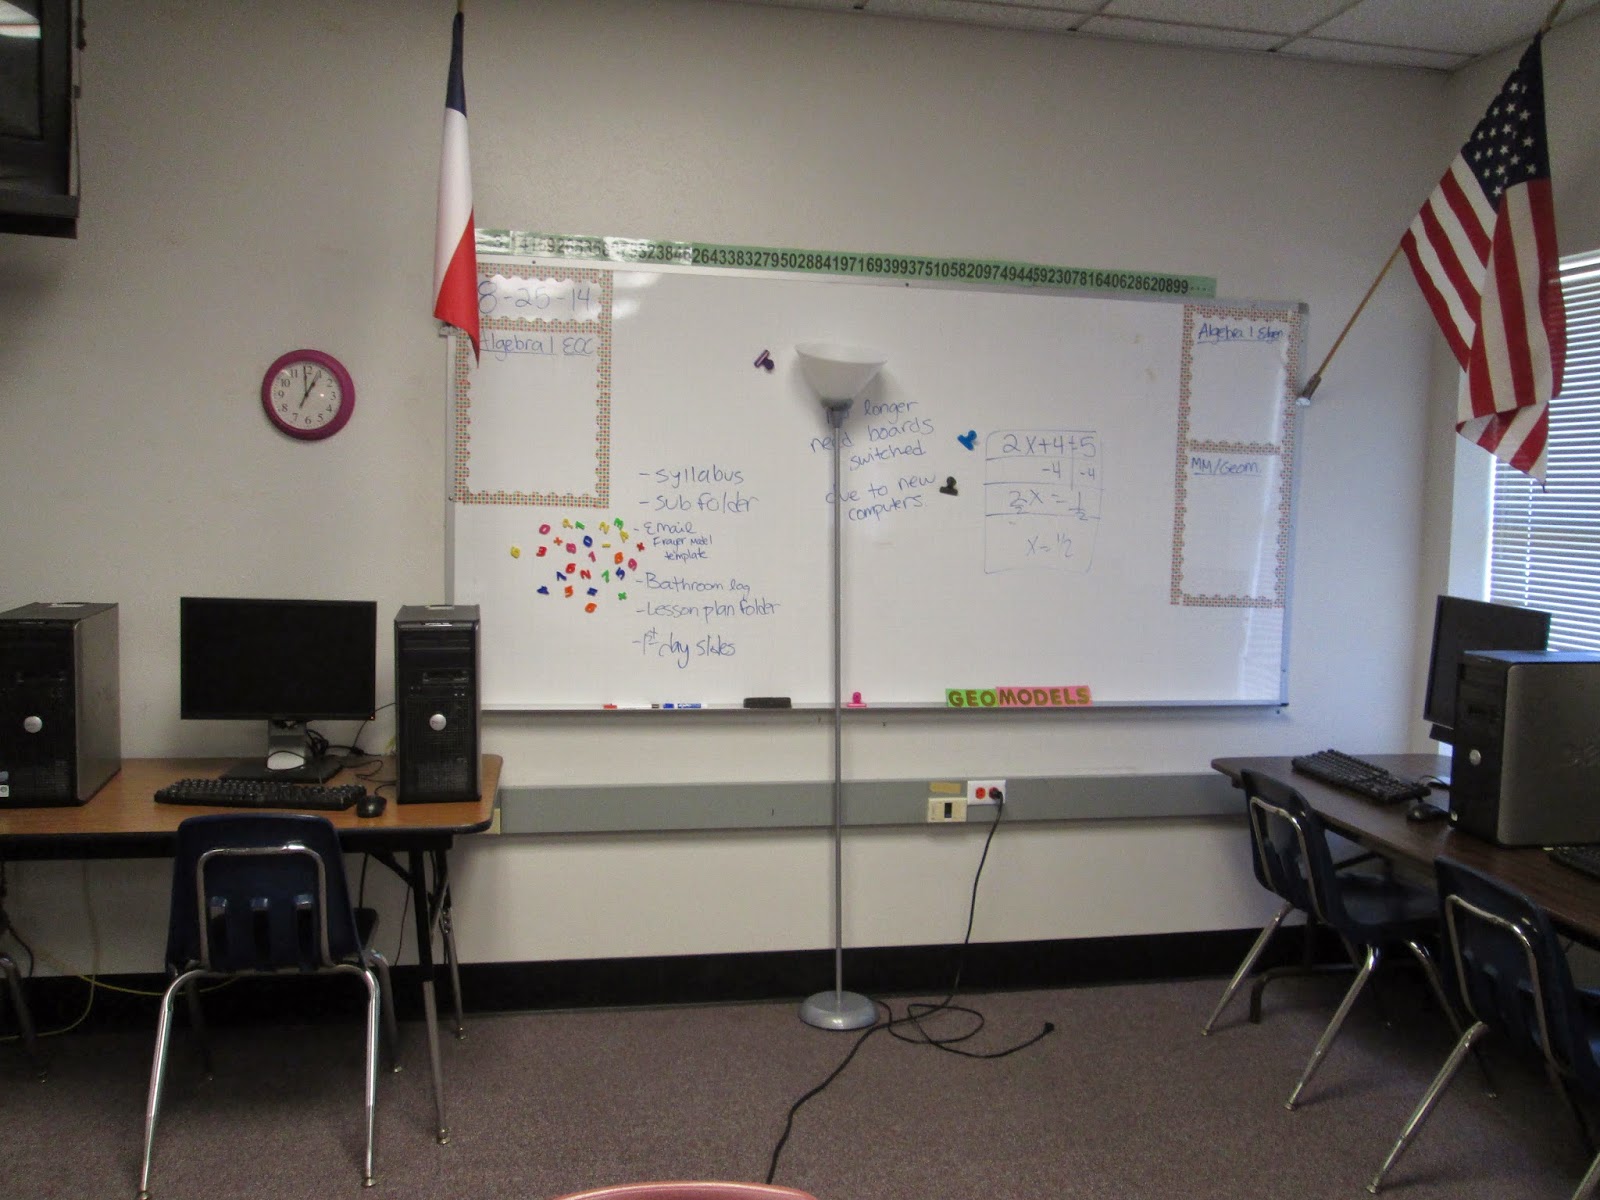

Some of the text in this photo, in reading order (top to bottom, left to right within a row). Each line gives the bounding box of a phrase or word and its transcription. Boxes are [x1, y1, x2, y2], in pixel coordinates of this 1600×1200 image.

[863, 399, 919, 424] longer
[867, 417, 934, 442] boards
[850, 439, 927, 472] switched
[867, 483, 888, 499] to
[897, 473, 936, 492] new
[848, 494, 924, 522] computers
[664, 547, 708, 564] template
[704, 600, 735, 624] plan
[658, 632, 690, 669] day
[948, 687, 1091, 708] GEO MODELS
